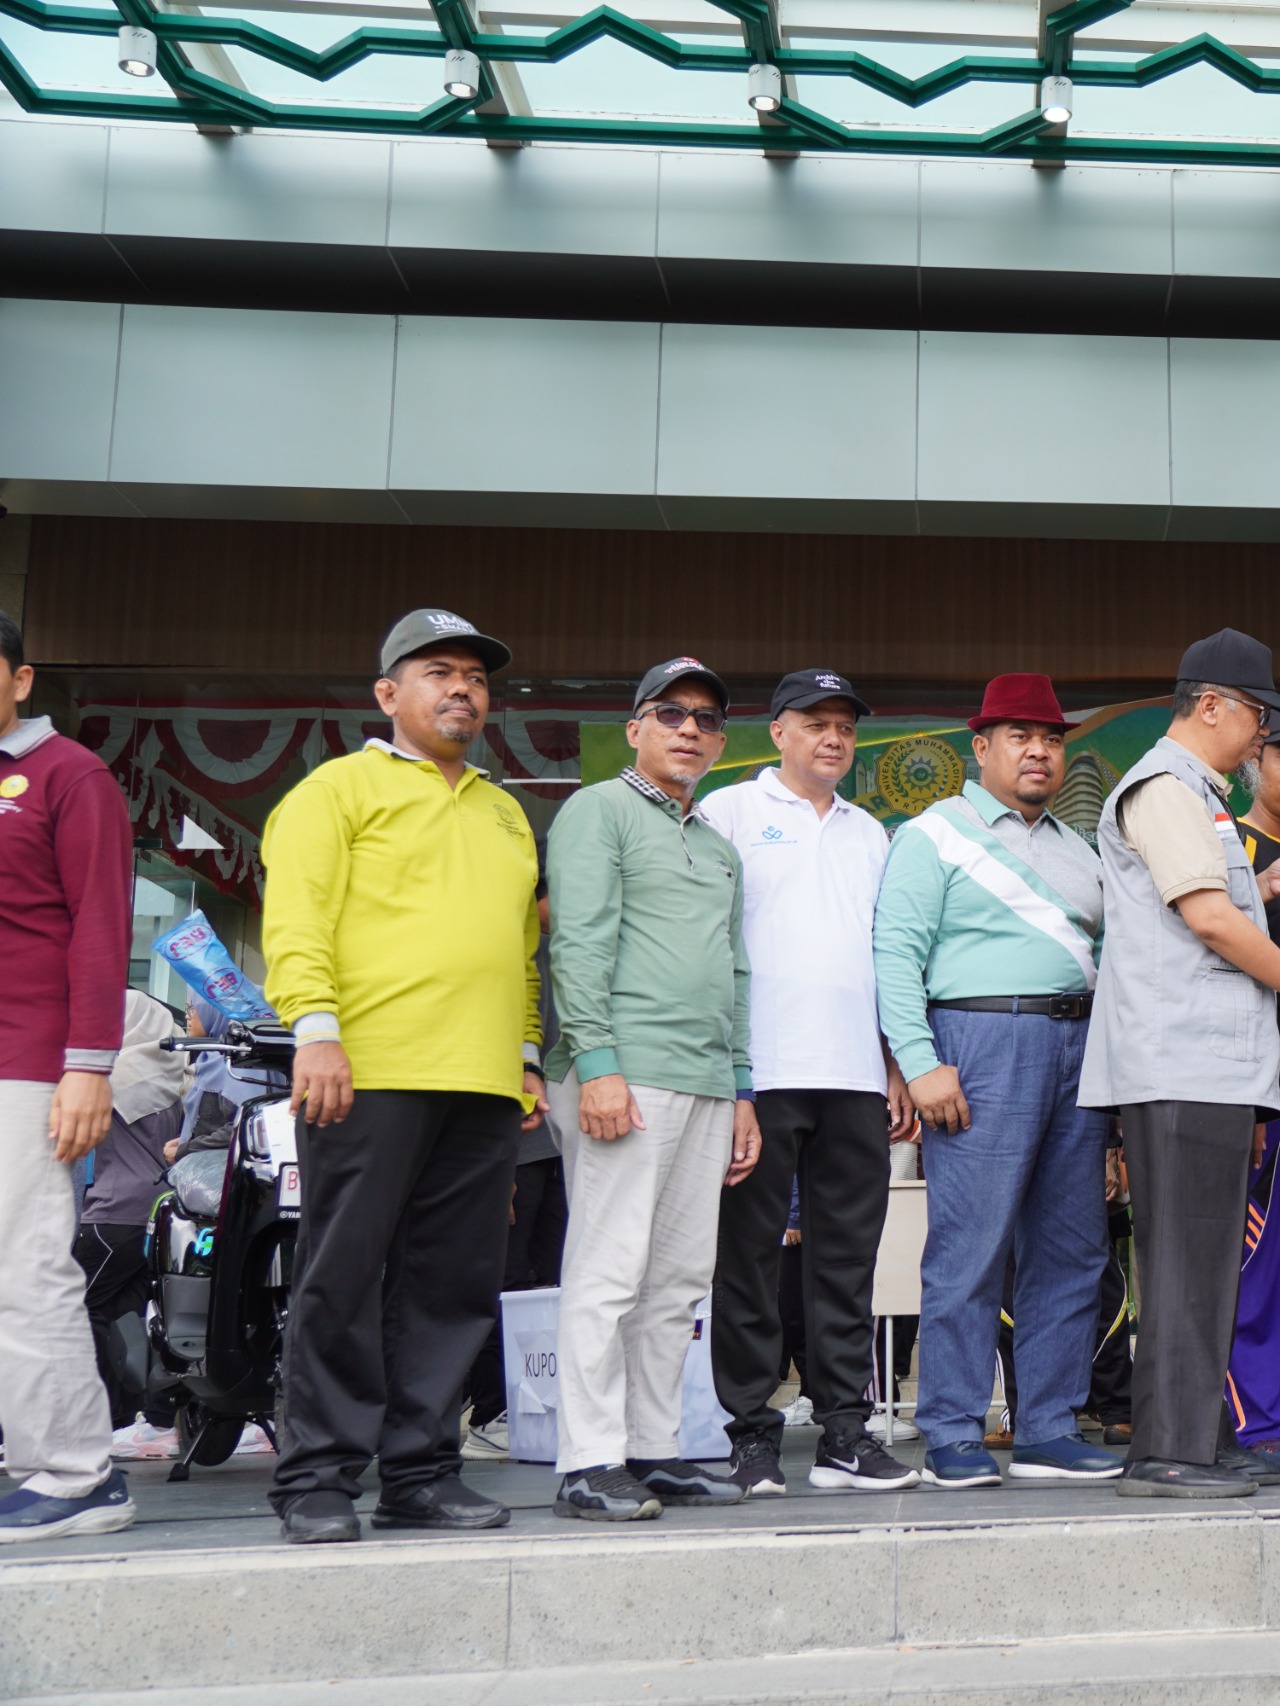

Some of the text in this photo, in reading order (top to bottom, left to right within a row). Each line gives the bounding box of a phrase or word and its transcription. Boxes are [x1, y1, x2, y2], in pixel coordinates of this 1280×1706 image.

[881, 739, 960, 797] UNIVERSITAS MUHAMMADIYAH
[525, 1352, 557, 1377] KUPO
